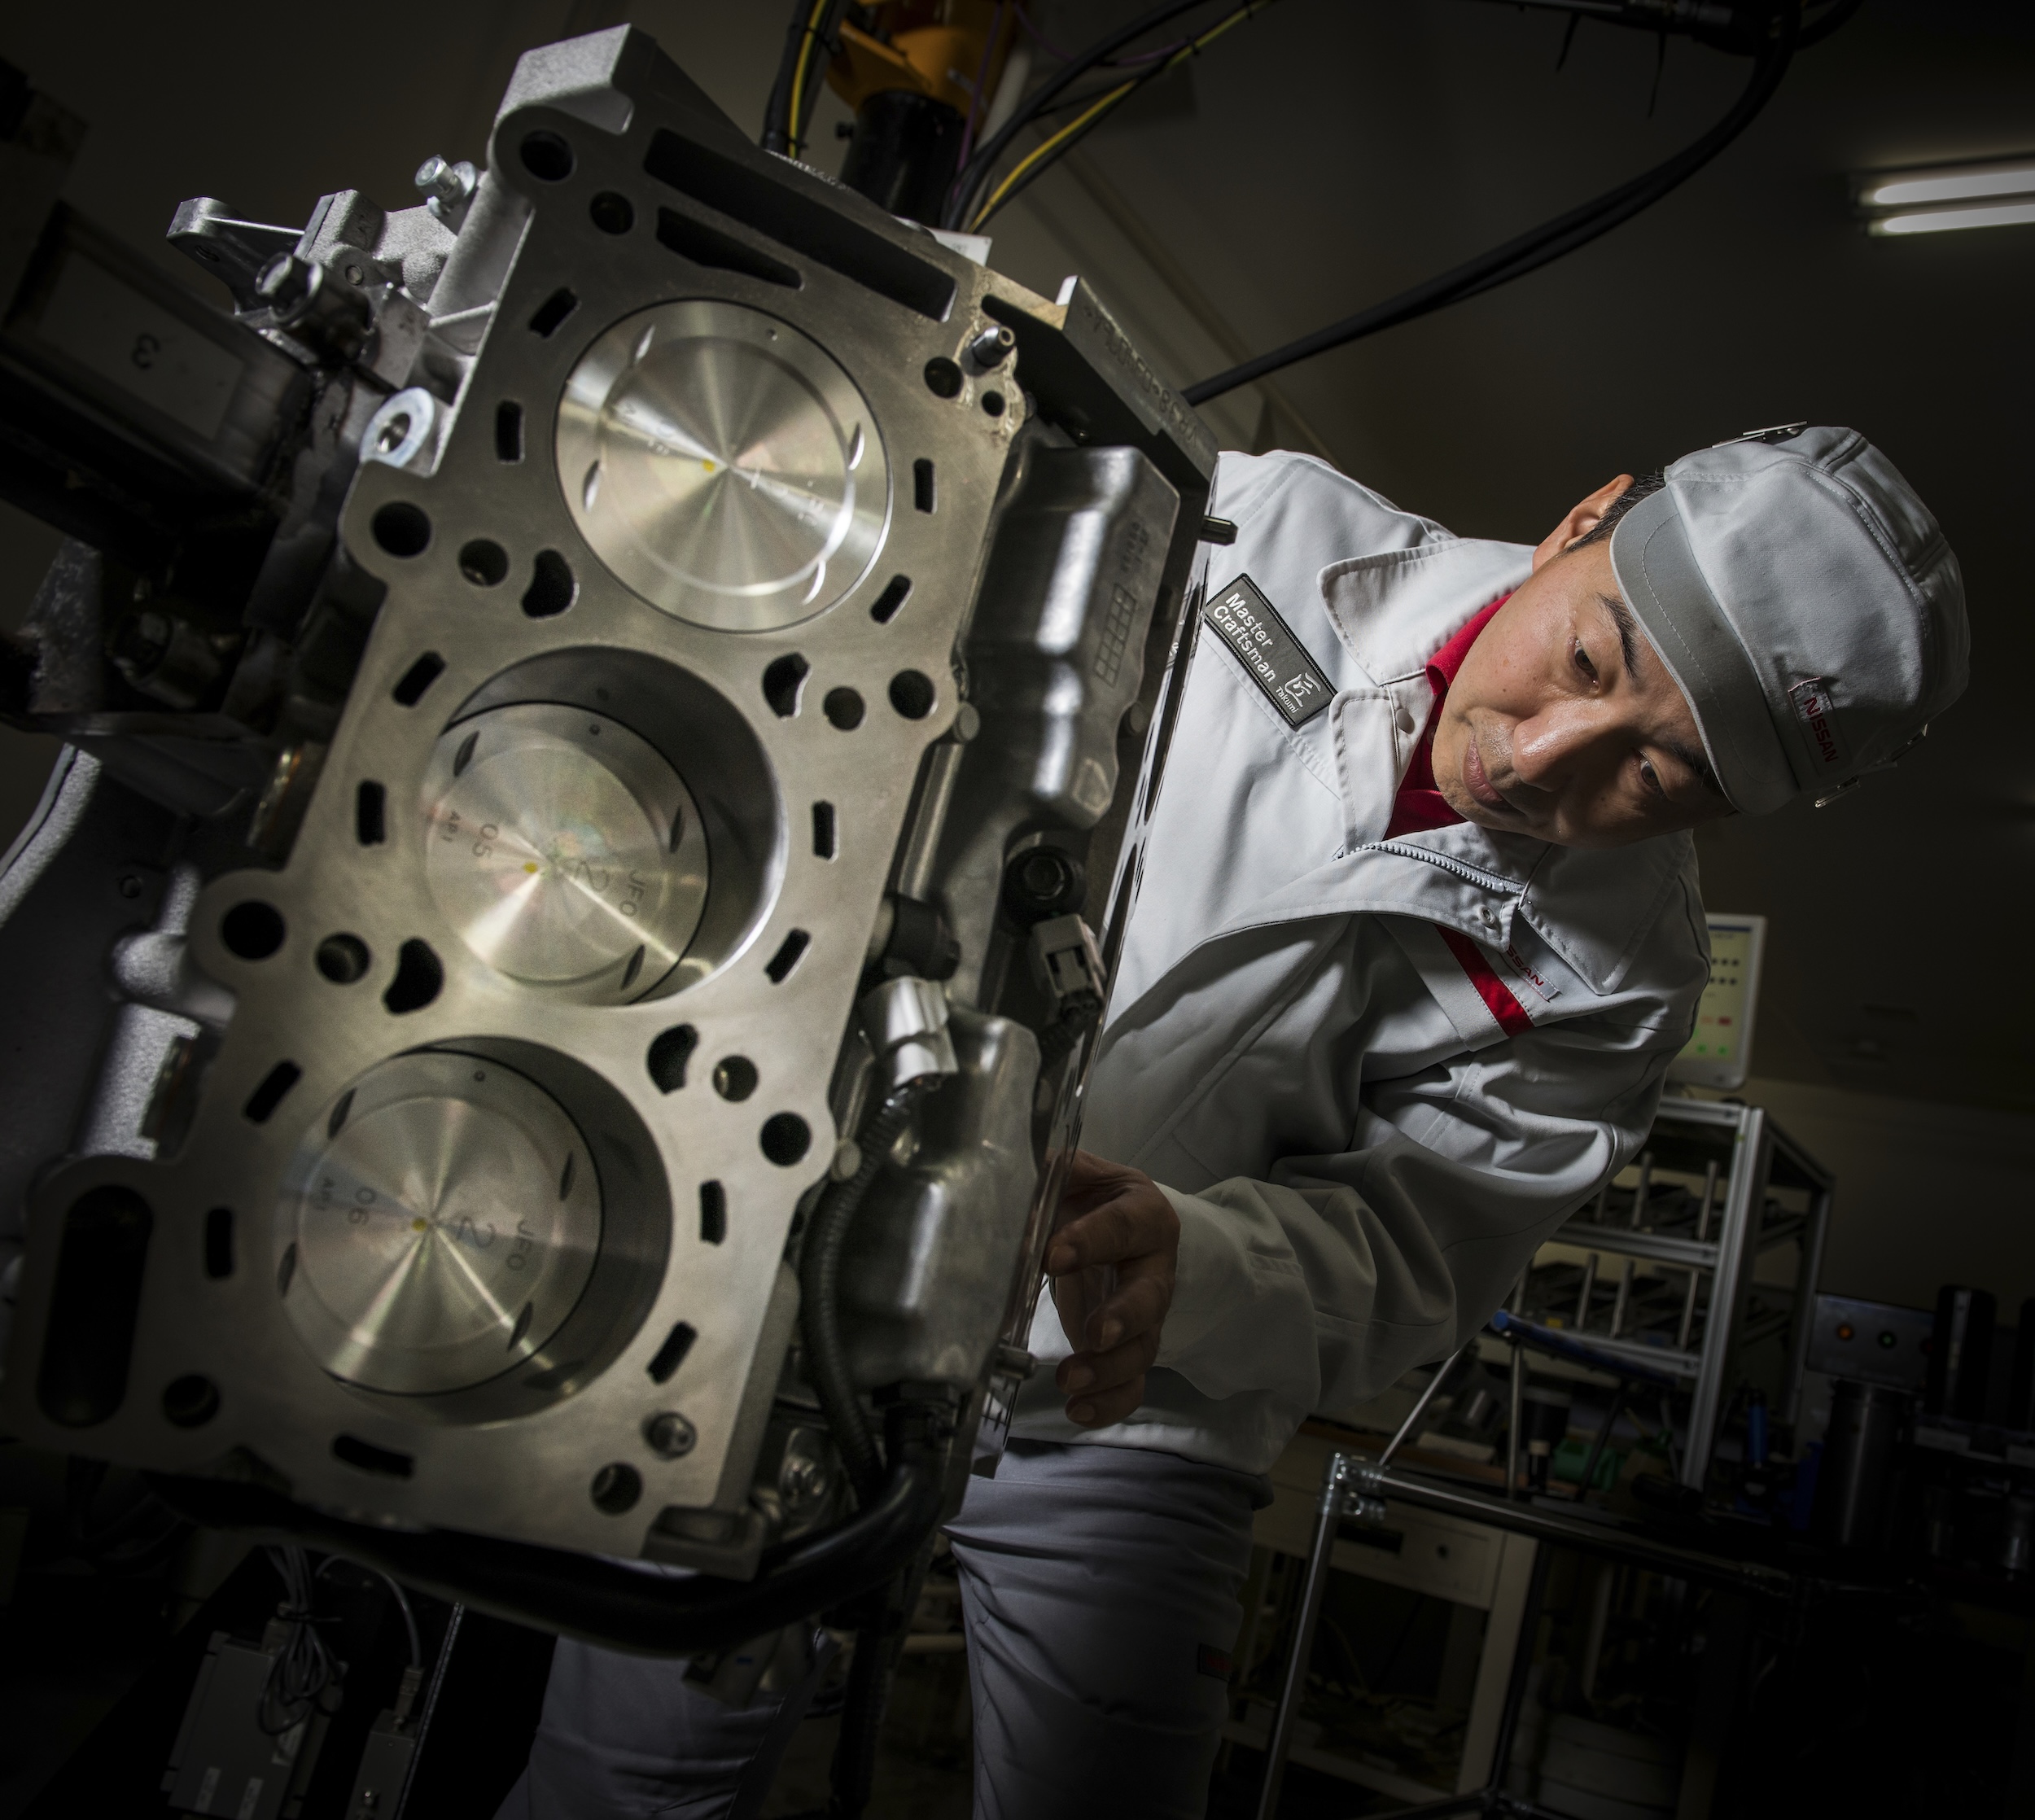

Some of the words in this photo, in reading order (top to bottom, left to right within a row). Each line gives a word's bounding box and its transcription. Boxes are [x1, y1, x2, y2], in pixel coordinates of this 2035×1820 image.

[1214, 606, 1277, 682] Craftsman
[1225, 593, 1274, 647] Master
[1276, 686, 1298, 714] Takumi
[1284, 672, 1321, 707] 匠
[1803, 697, 1839, 763] NISSAN
